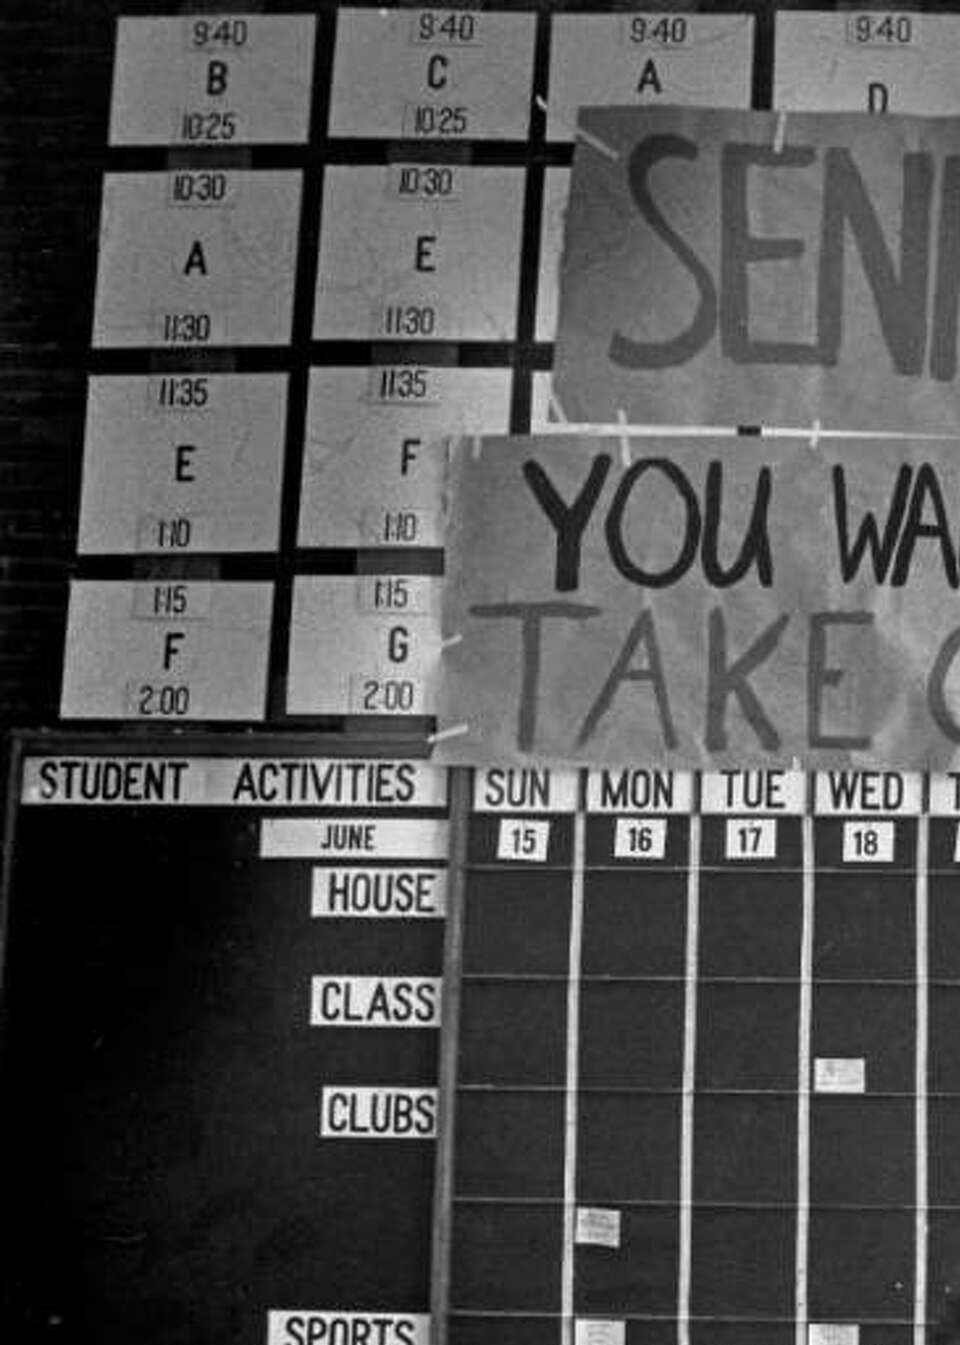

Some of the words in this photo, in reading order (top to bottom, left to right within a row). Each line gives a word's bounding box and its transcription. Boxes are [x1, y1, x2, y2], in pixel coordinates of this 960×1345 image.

[419, 14, 474, 40] 9:40
[630, 18, 687, 43] 9:40
[857, 18, 912, 43] 9:40
[207, 61, 227, 95] B
[428, 55, 449, 89] C
[637, 59, 661, 93] A
[416, 108, 466, 135] 10:25
[184, 241, 207, 275] A
[416, 237, 436, 272] E
[176, 446, 195, 482] E
[403, 440, 420, 475] F
[523, 454, 773, 592] YOU
[165, 633, 184, 669] F
[389, 627, 408, 662] G
[469, 602, 875, 752] TAKE
[39, 762, 189, 800] STUDENT
[233, 763, 416, 801] ACTIVITIES
[485, 769, 550, 807] SUN
[601, 769, 673, 808] MON
[722, 769, 786, 809] TUE
[829, 770, 903, 810] WED
[320, 825, 376, 850] JUNE
[512, 828, 536, 855] 15
[628, 827, 652, 853] 16
[738, 827, 762, 853] 17
[854, 829, 878, 856] 18
[329, 873, 436, 912] HOUSE
[322, 982, 435, 1021] CLASS
[328, 1093, 435, 1134] CLUBS
